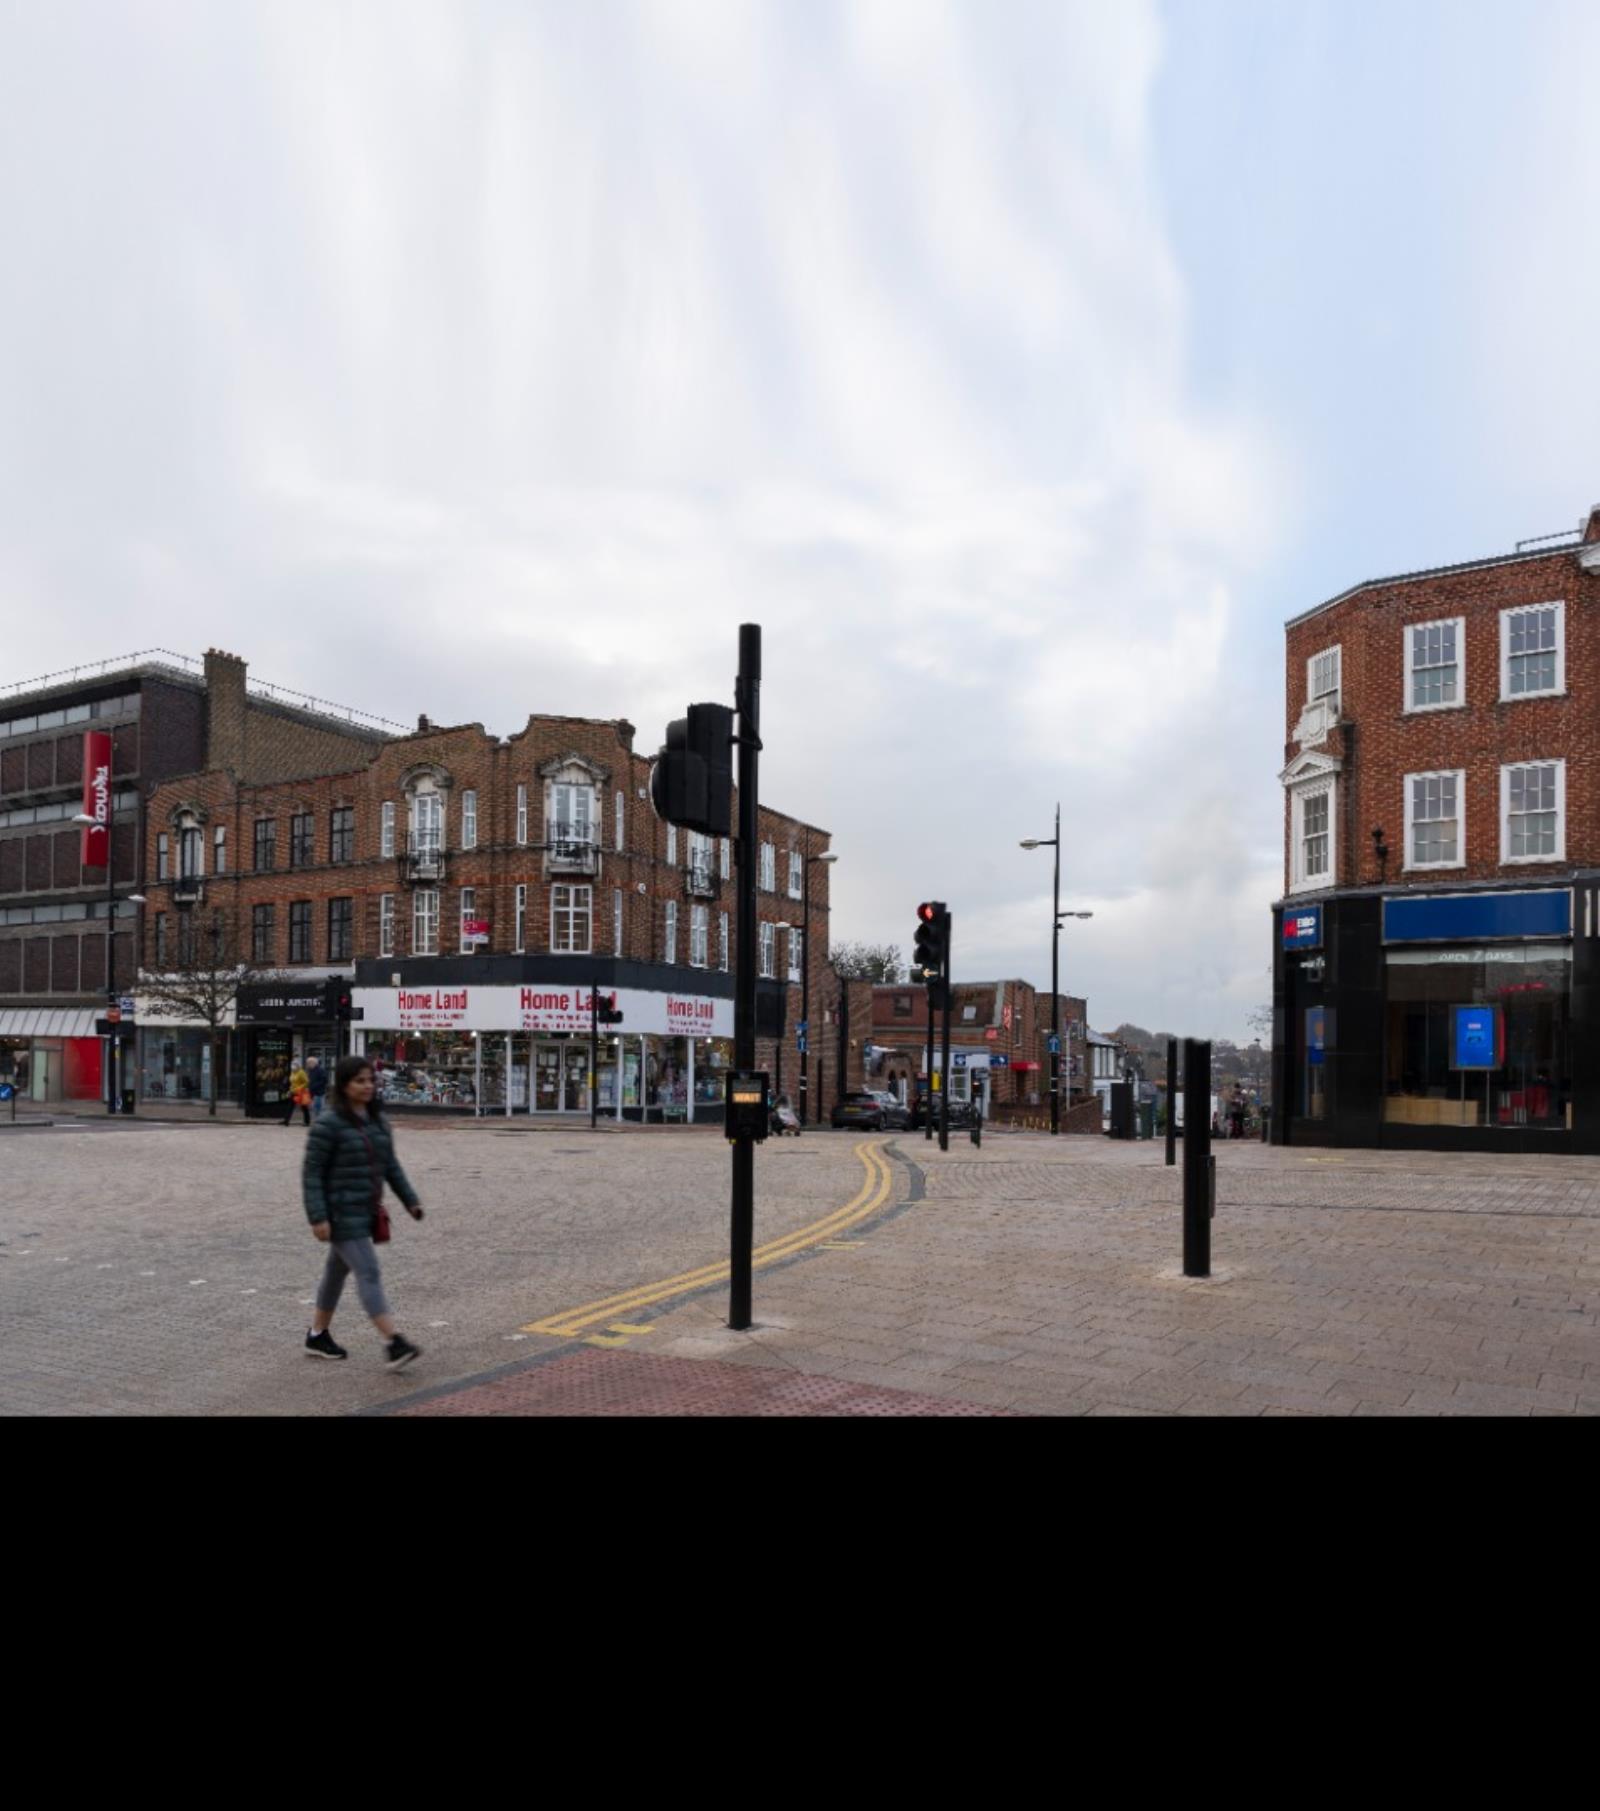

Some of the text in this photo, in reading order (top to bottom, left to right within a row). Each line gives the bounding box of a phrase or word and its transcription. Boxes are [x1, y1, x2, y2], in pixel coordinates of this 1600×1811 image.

[398, 989, 468, 1010] Home Land
[520, 987, 617, 1012] Home Lad
[666, 996, 714, 1019] Home Land
[733, 1092, 761, 1103] WAIT
